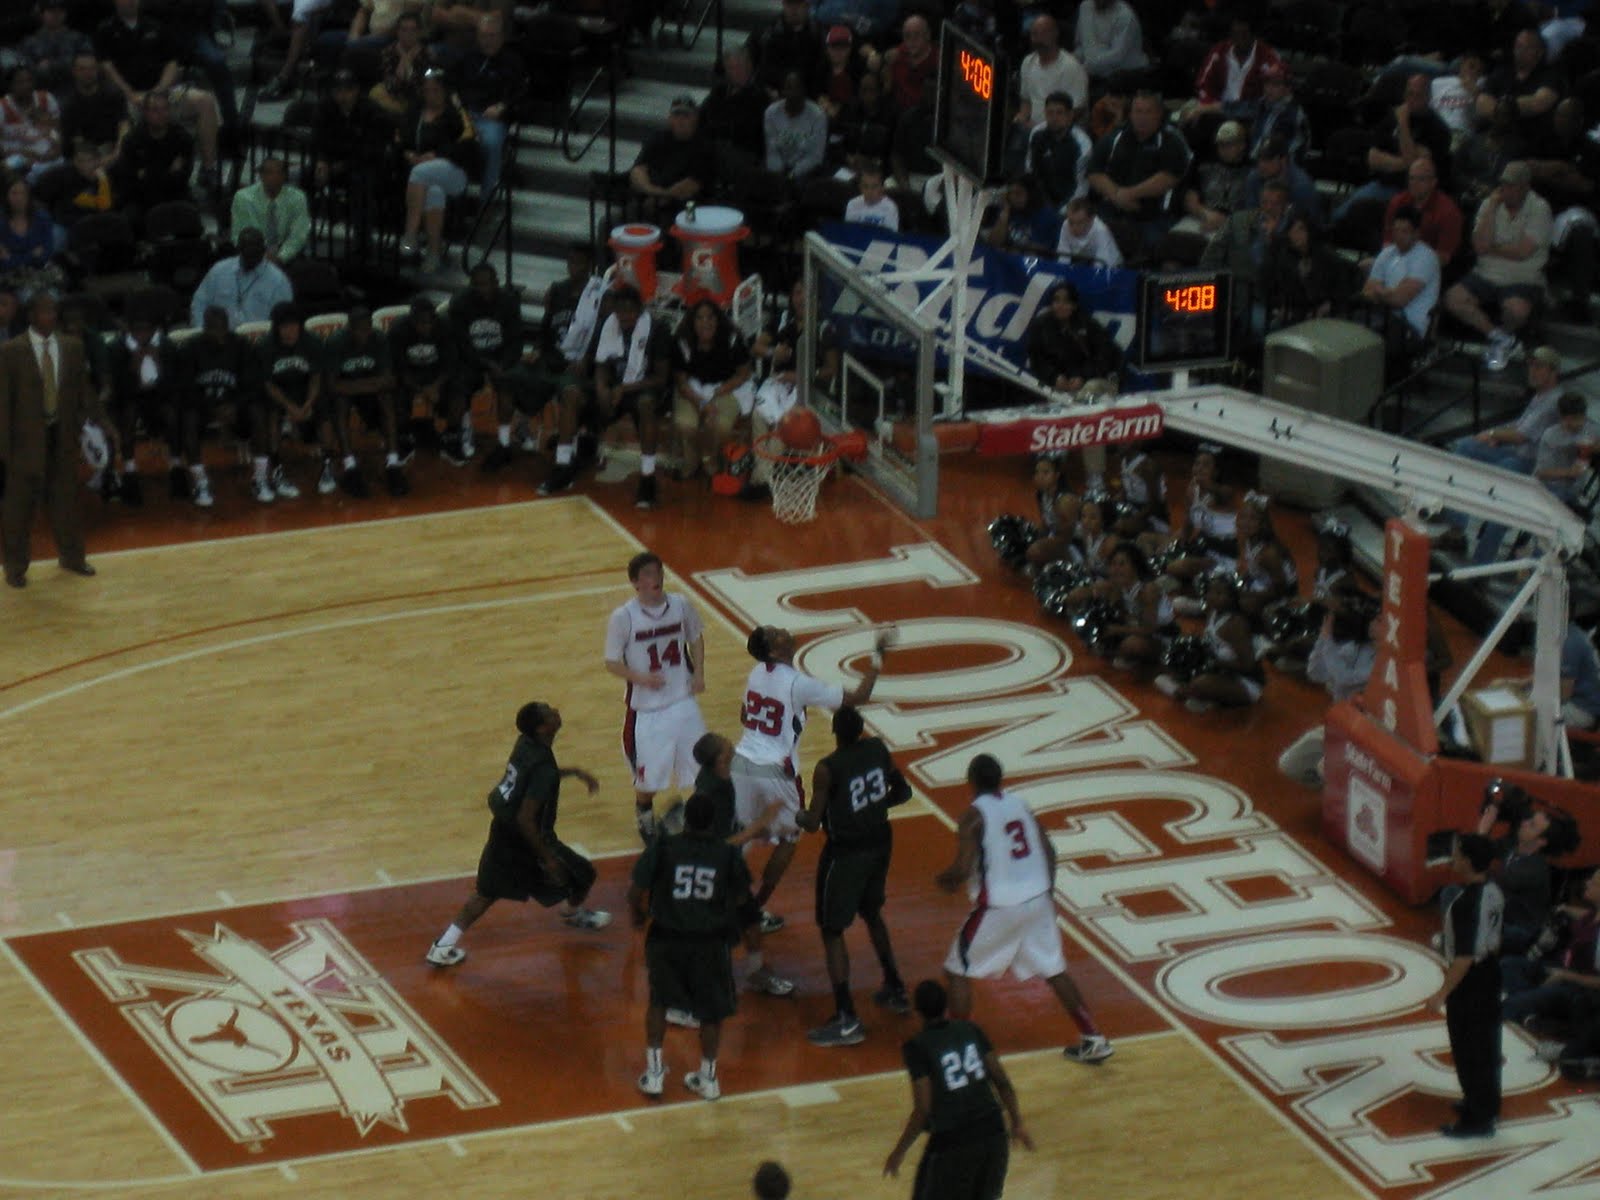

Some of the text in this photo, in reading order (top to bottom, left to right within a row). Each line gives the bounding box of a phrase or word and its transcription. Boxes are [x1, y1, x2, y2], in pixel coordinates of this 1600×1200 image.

[960, 50, 992, 99] 4:08
[691, 248, 713, 268] G
[1165, 284, 1216, 311] 4:08
[1384, 528, 1404, 732] TEXAS
[647, 638, 682, 673] 14
[740, 690, 785, 737] 23
[850, 767, 887, 812] 23
[1004, 820, 1029, 859] 3
[672, 864, 717, 900] 55
[271, 987, 351, 1061] TEXAS
[940, 1042, 986, 1091] 24
